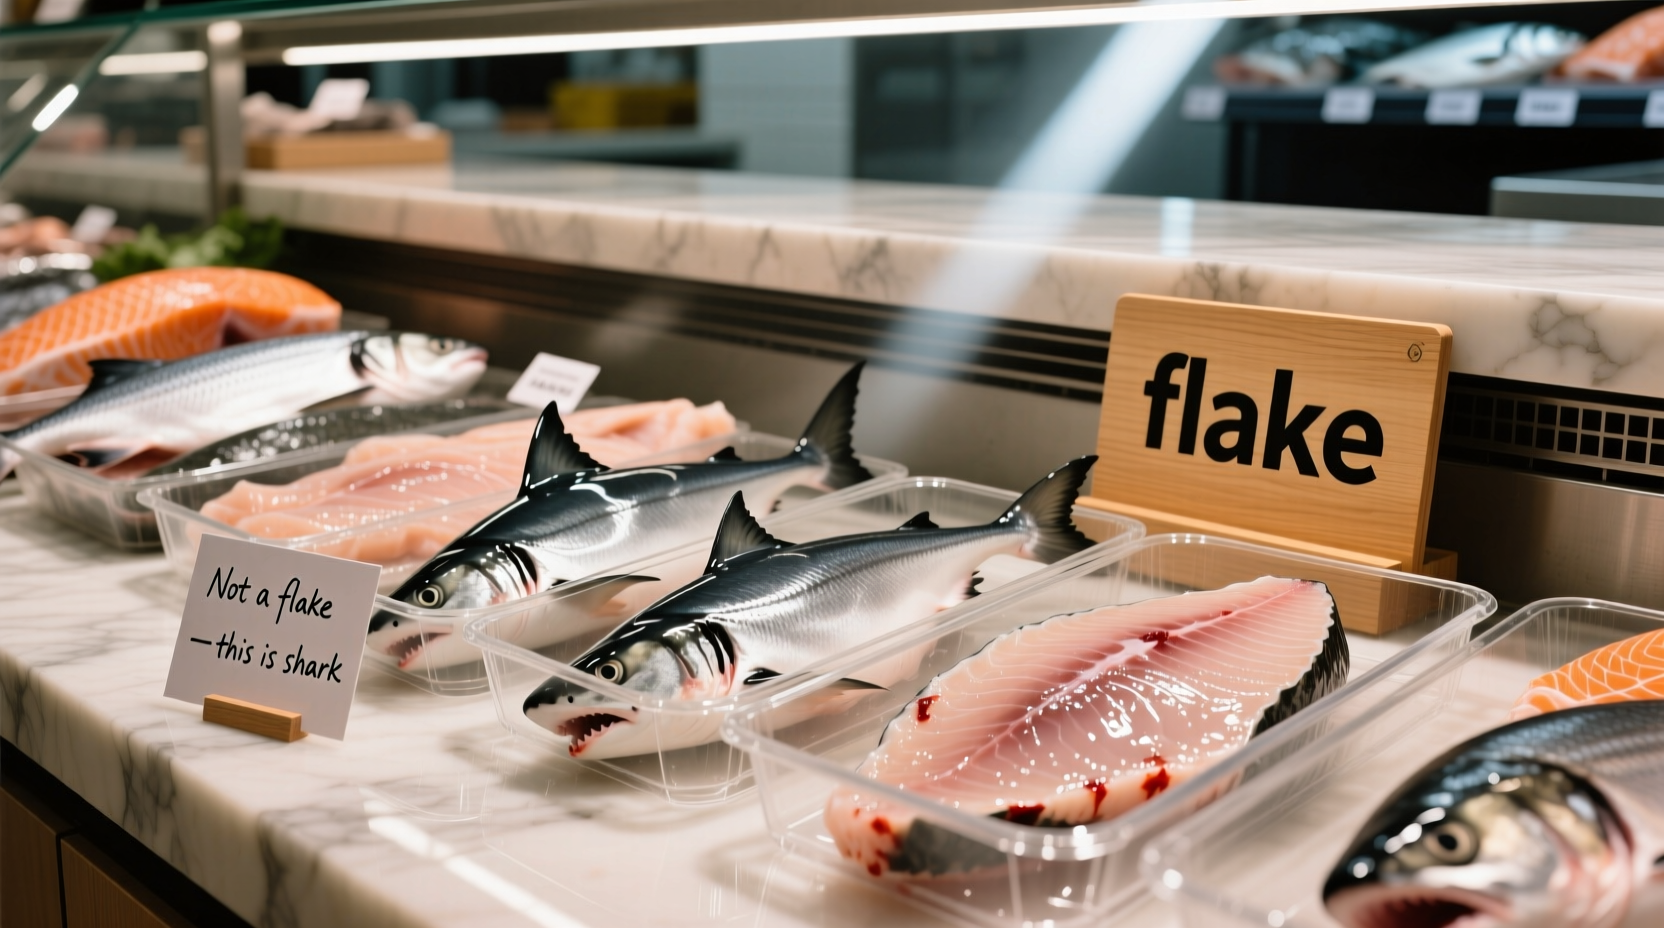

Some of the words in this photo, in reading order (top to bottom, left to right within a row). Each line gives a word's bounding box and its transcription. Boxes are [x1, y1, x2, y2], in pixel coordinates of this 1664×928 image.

[1143, 351, 1385, 486] flake
[206, 566, 252, 604] Not
[256, 588, 270, 608] a
[275, 577, 333, 625] flake
[260, 643, 278, 670] is
[282, 644, 343, 684] shark
